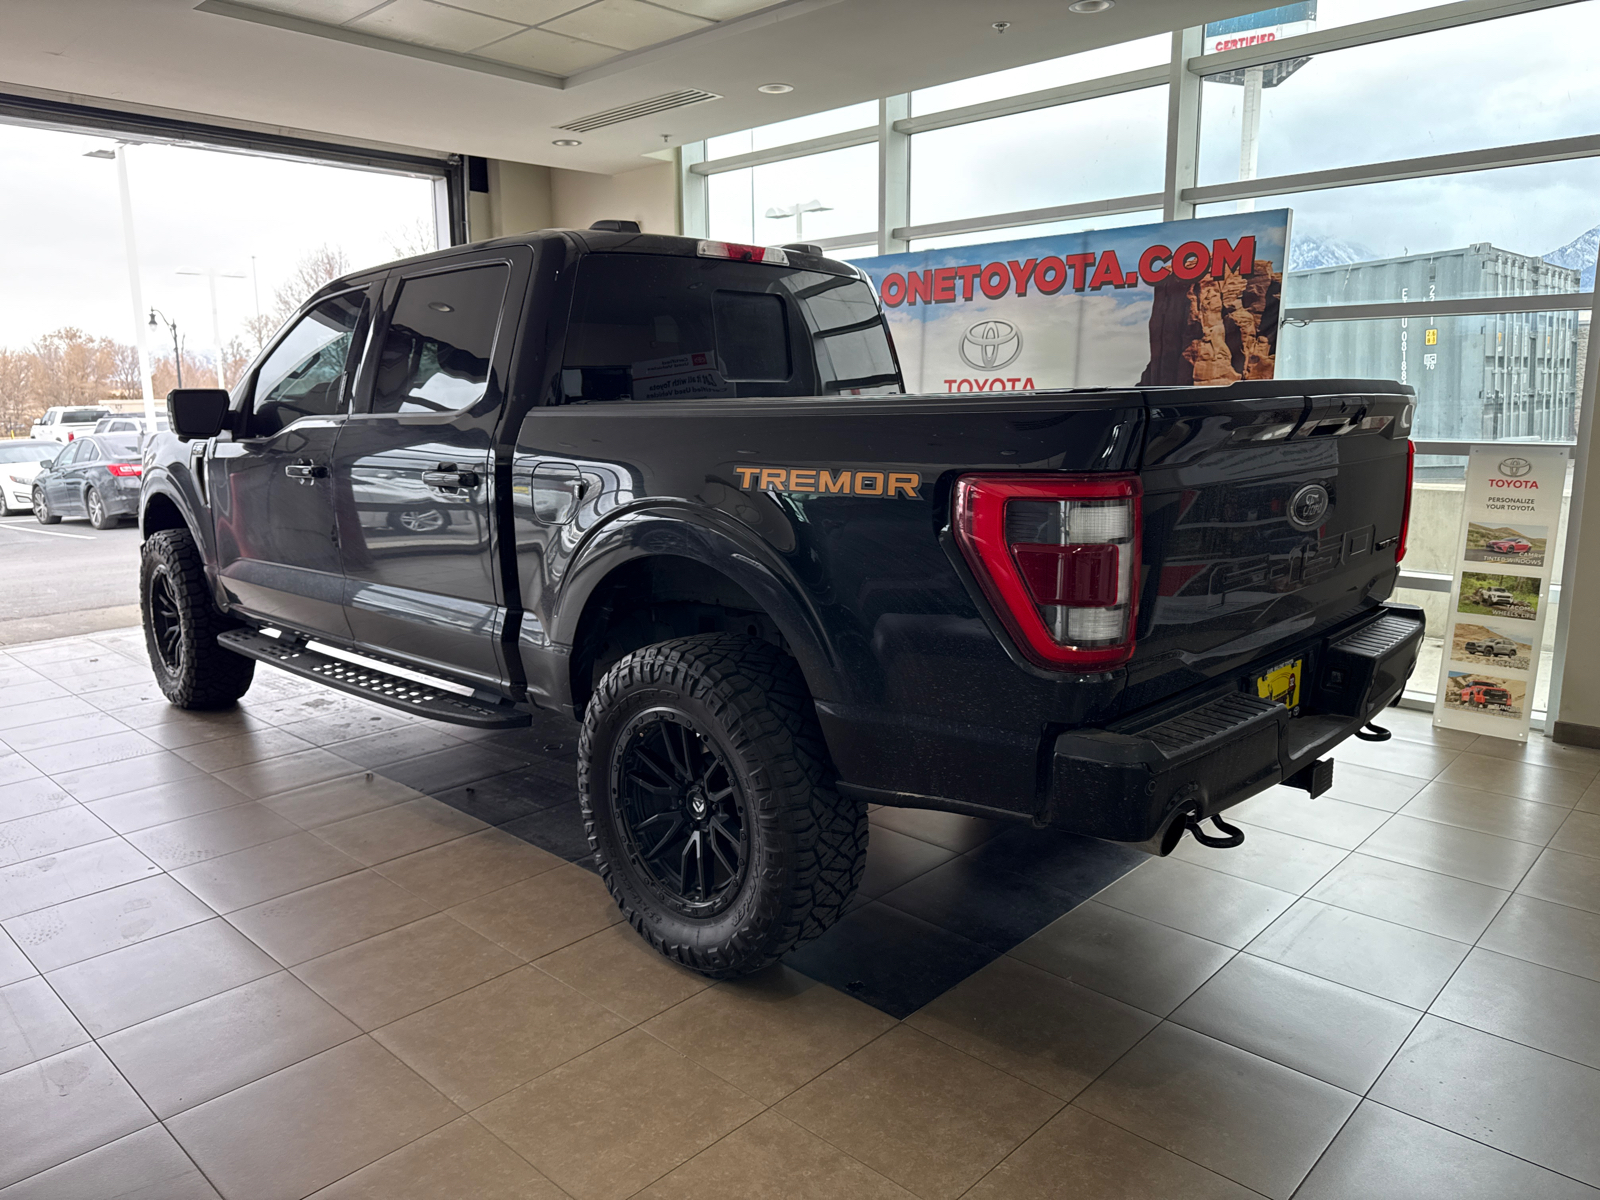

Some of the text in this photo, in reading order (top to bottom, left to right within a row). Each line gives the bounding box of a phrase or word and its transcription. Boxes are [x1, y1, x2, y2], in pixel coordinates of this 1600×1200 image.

[1215, 32, 1276, 51] CERTIFIED
[880, 235, 1256, 308] ONETOYOTA.COM
[944, 377, 1035, 393] TOYOTA
[735, 466, 920, 498] TREMOR
[1488, 478, 1539, 489] TOYOTA
[1303, 494, 1324, 516] Ford
[1487, 496, 1535, 505] PERSONALIZE
[1207, 524, 1376, 610] F-150
[1505, 557, 1542, 565] WINDOWS
